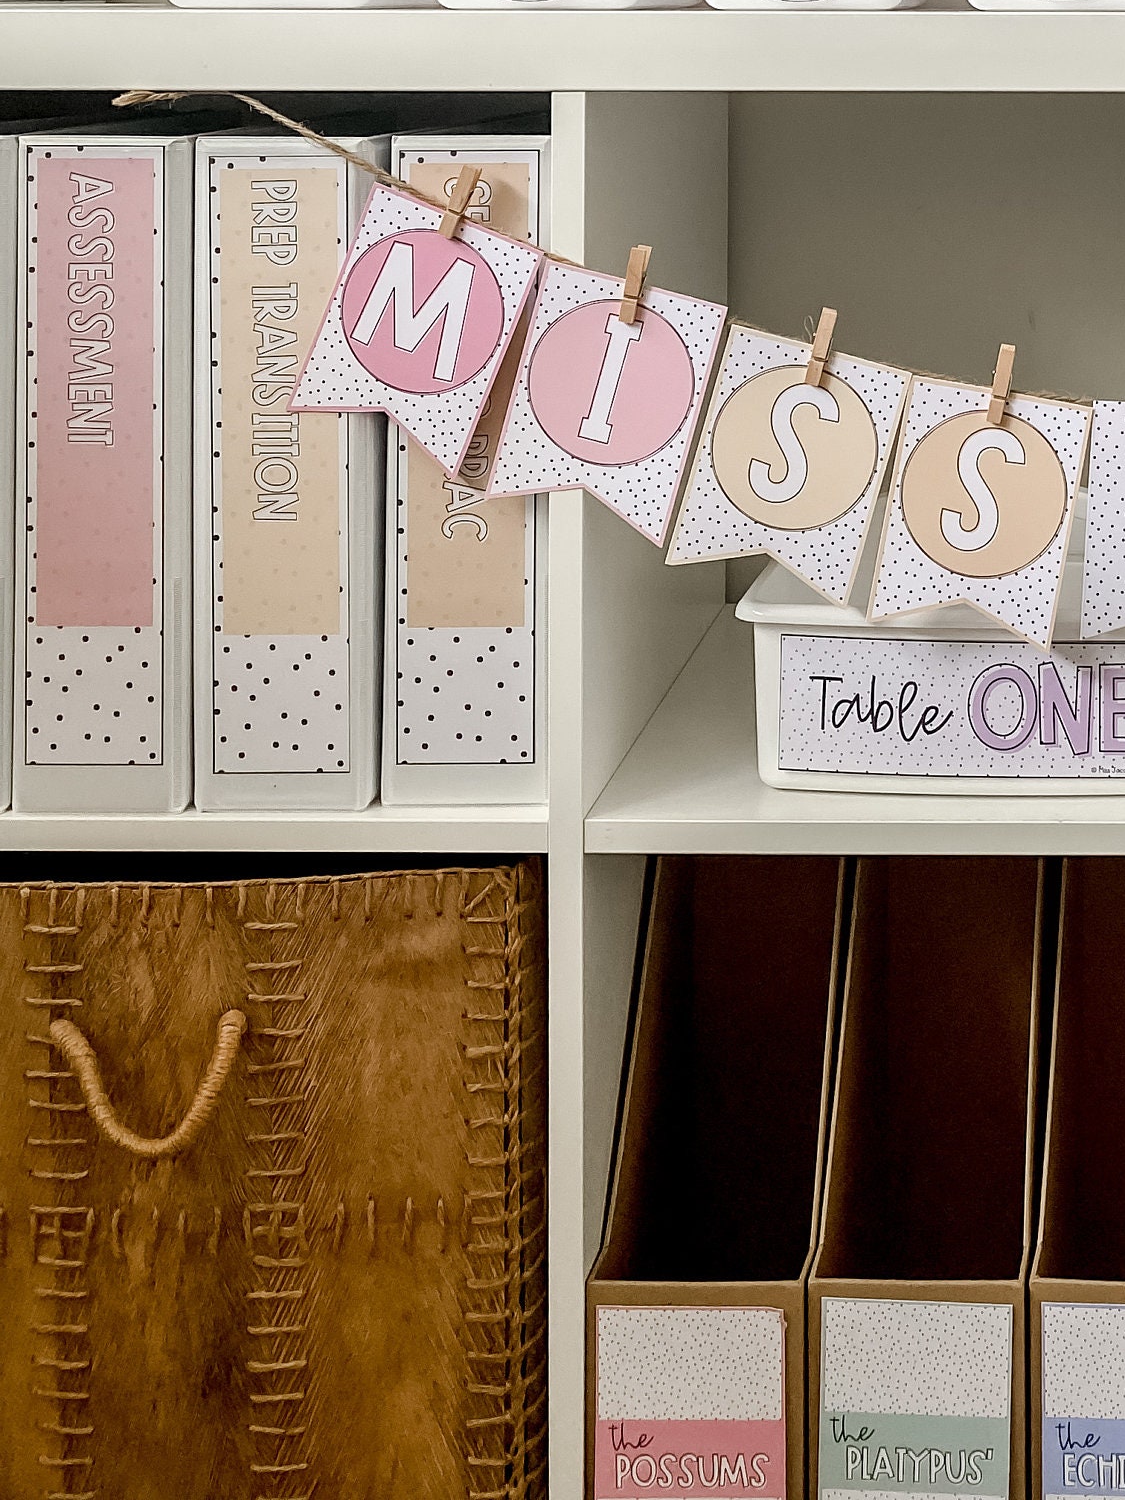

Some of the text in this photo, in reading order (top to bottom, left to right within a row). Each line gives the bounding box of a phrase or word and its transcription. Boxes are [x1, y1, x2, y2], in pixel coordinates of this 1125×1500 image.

[66, 172, 115, 446] ASSESSMENT
[251, 180, 299, 522] PREP TRANSITION
[809, 675, 954, 742] Table
[608, 1422, 655, 1452] the
[829, 1415, 875, 1445] the
[1054, 1420, 1101, 1452] the
[614, 1452, 770, 1489] POSSUMS
[845, 1446, 995, 1486] PLATYPUS'
